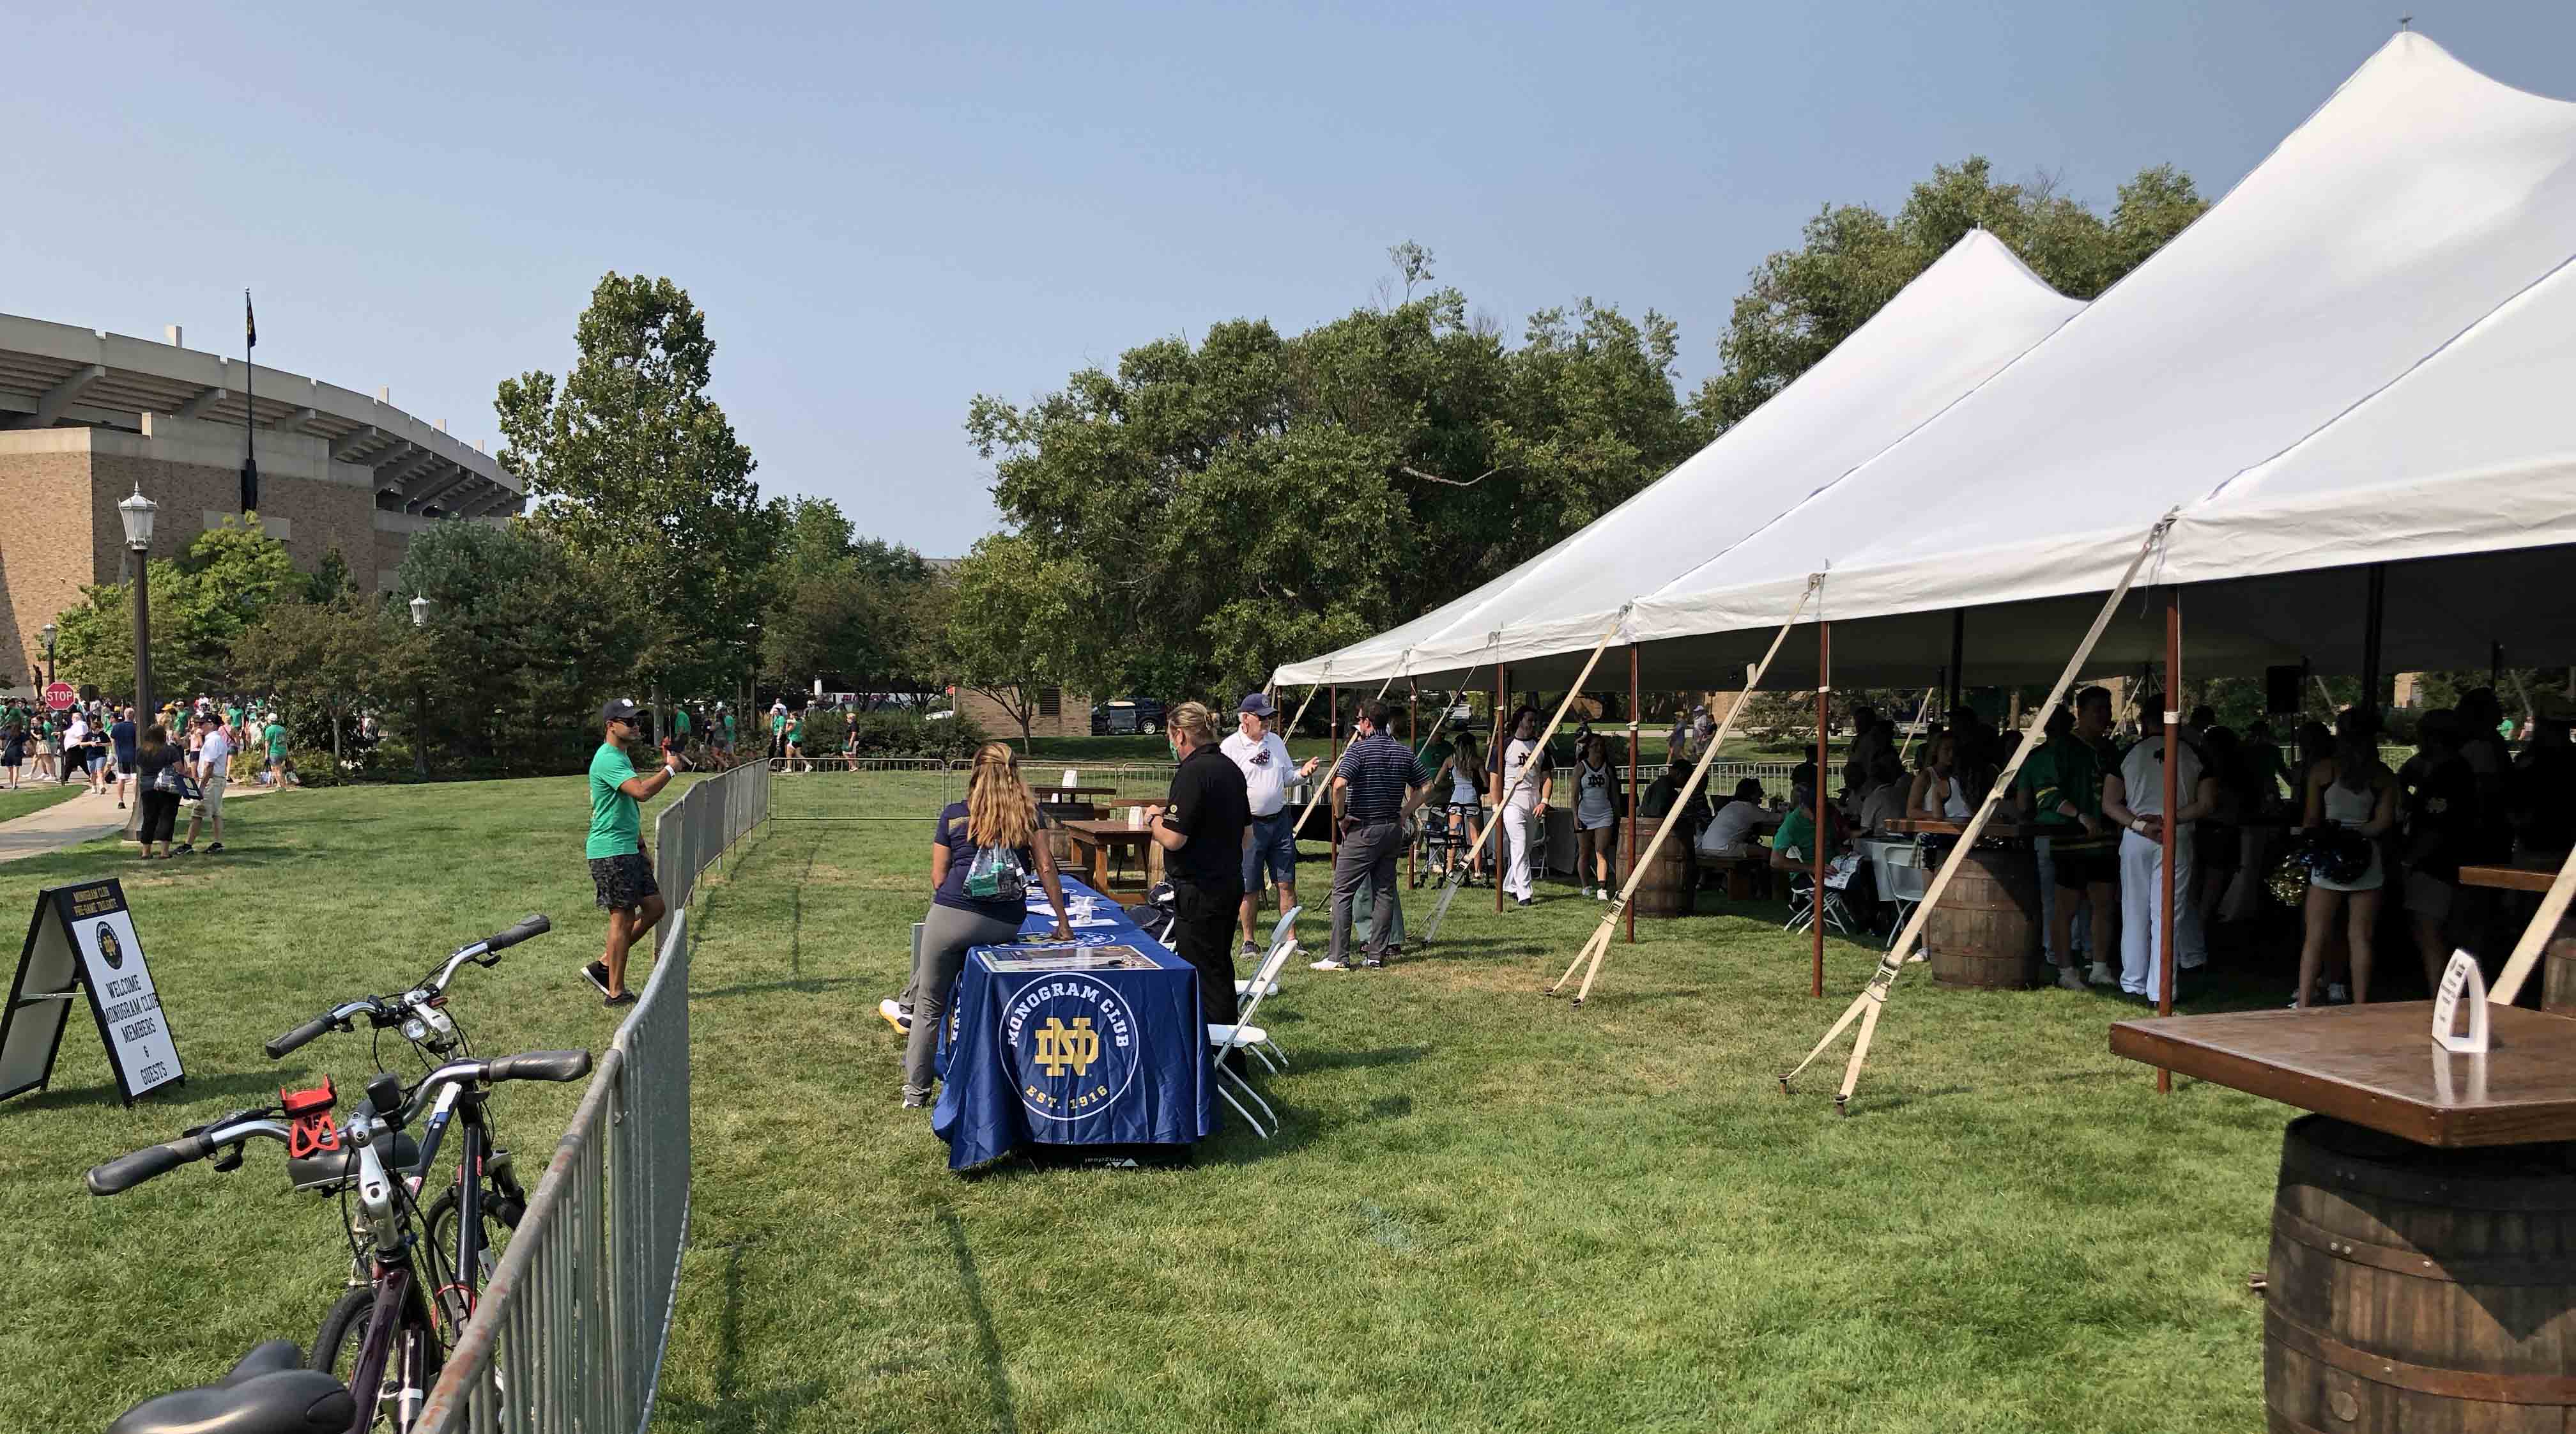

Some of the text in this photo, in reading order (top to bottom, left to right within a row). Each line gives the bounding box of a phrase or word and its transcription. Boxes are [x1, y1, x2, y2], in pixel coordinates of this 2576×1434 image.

[47, 691, 72, 702] STOP
[105, 975, 142, 999] WELCOME
[104, 992, 160, 1024] MONOGRAM CLUB
[1008, 982, 1130, 1048] MONOGRAM CLUB
[120, 1017, 157, 1044] MEMBERS
[143, 1045, 150, 1058] &
[140, 1061, 168, 1086] GUESTS
[1025, 1085, 1108, 1109] EST. 1916
